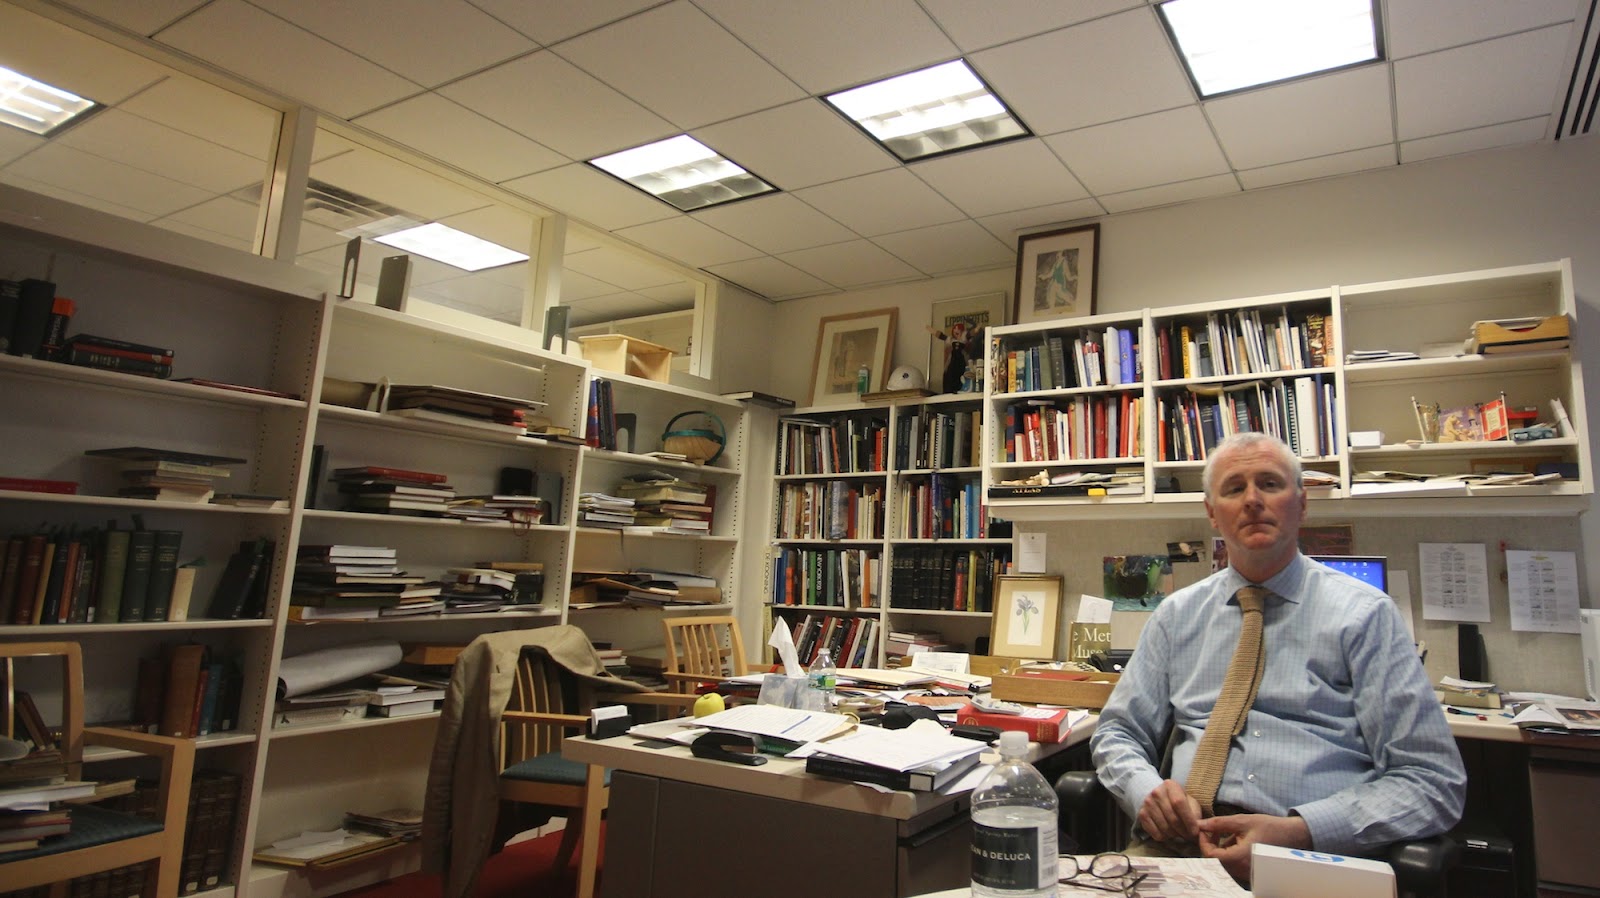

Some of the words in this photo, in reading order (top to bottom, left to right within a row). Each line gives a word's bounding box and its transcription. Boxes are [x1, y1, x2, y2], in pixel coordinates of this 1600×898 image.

[1083, 627, 1112, 643] Met
[982, 849, 988, 858] &
[989, 851, 1032, 861] DELUCA
